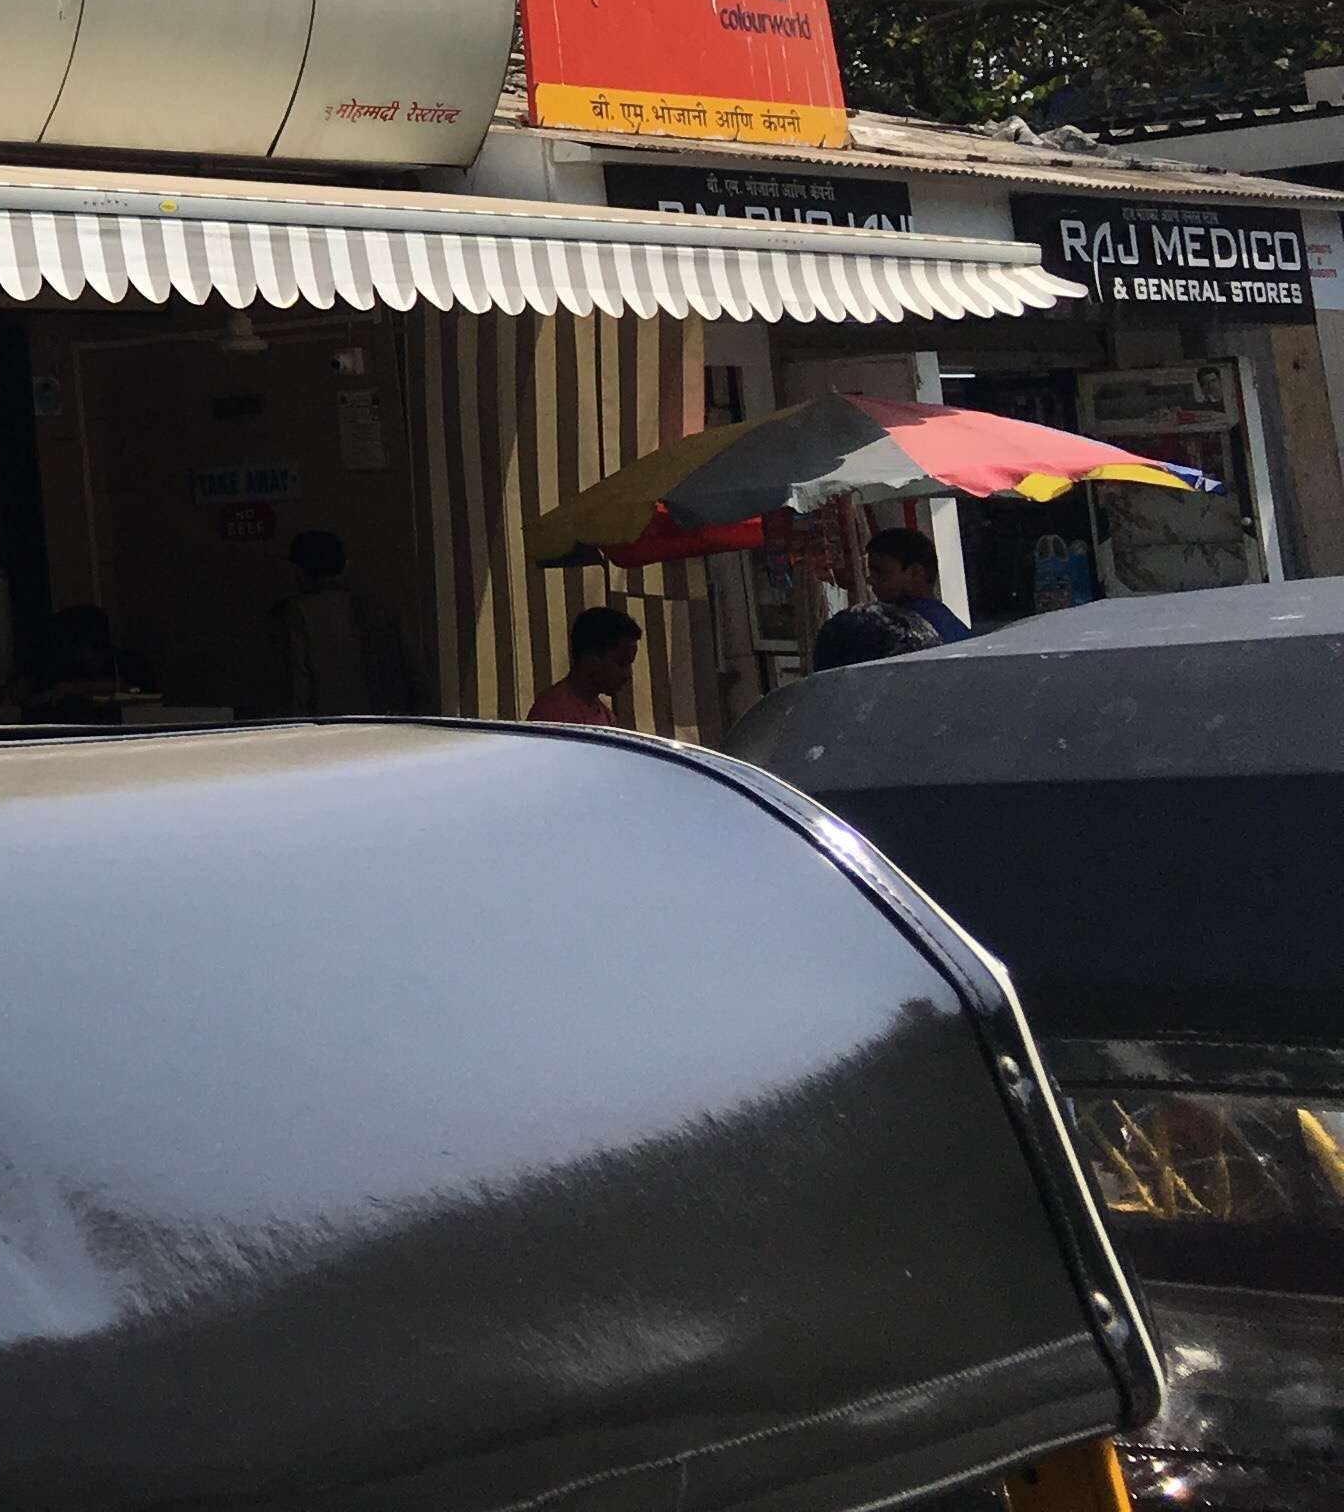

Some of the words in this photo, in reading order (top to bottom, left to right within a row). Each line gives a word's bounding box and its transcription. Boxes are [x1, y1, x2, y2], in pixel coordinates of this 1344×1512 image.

[720, 4, 812, 40] colourworld
[652, 99, 708, 128] भोजानी
[716, 106, 754, 132] आणि
[759, 109, 802, 134] कंपनी
[1060, 219, 1139, 303] RAJ
[1151, 224, 1302, 272] MEDICO
[1112, 277, 1130, 300] &
[1133, 277, 1226, 303] GENERAL
[1231, 281, 1303, 304] STORES
